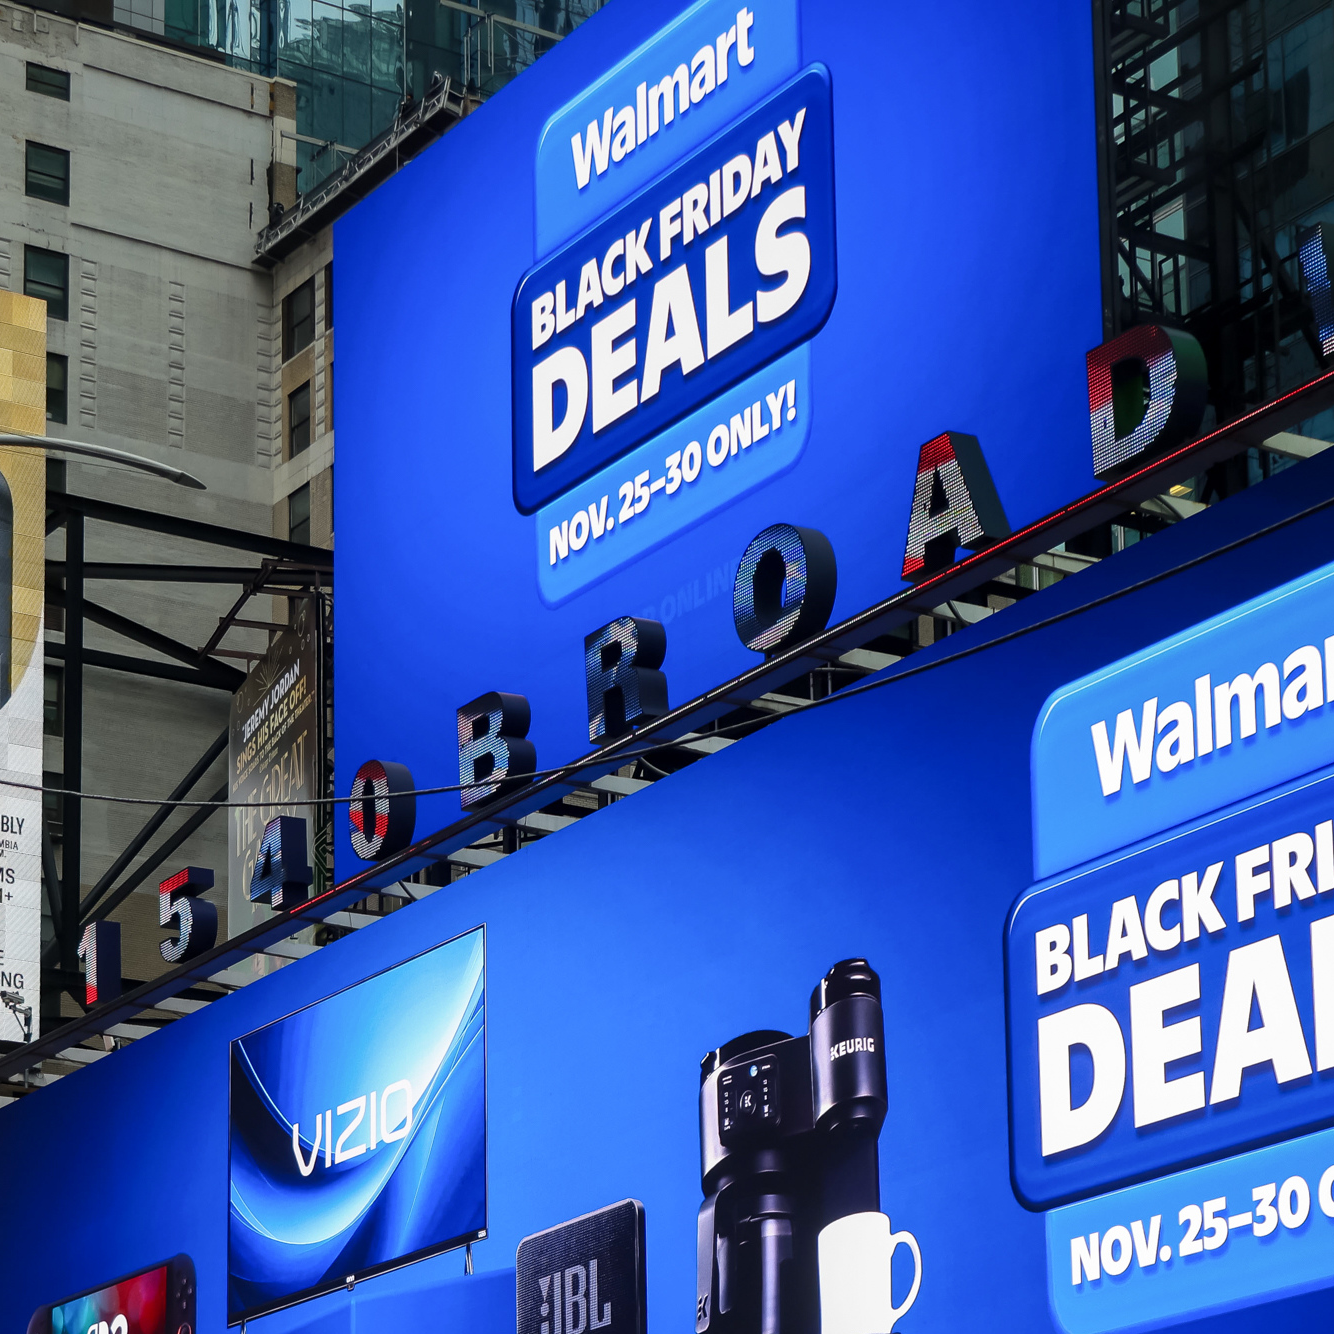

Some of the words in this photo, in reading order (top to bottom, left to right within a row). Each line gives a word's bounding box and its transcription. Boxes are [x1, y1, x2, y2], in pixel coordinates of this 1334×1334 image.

[571, 6, 755, 190] Walmart
[531, 220, 651, 351] BLACK
[658, 107, 807, 263] FRIDAY
[531, 185, 810, 473] DEALS
[548, 497, 616, 566] NOV.
[707, 380, 798, 468] ONLY!
[236, 741, 257, 775] SINGS
[257, 725, 269, 753] HIS
[269, 701, 288, 735] FACE
[289, 675, 307, 710] OFF!
[270, 658, 300, 710] JORDAN
[260, 730, 308, 828] GREAT
[1036, 861, 1226, 996] BLACK
[830, 1037, 875, 1061] KEURIG
[291, 1078, 414, 1178] VIZIO
[1071, 1214, 1171, 1286] NOV.
